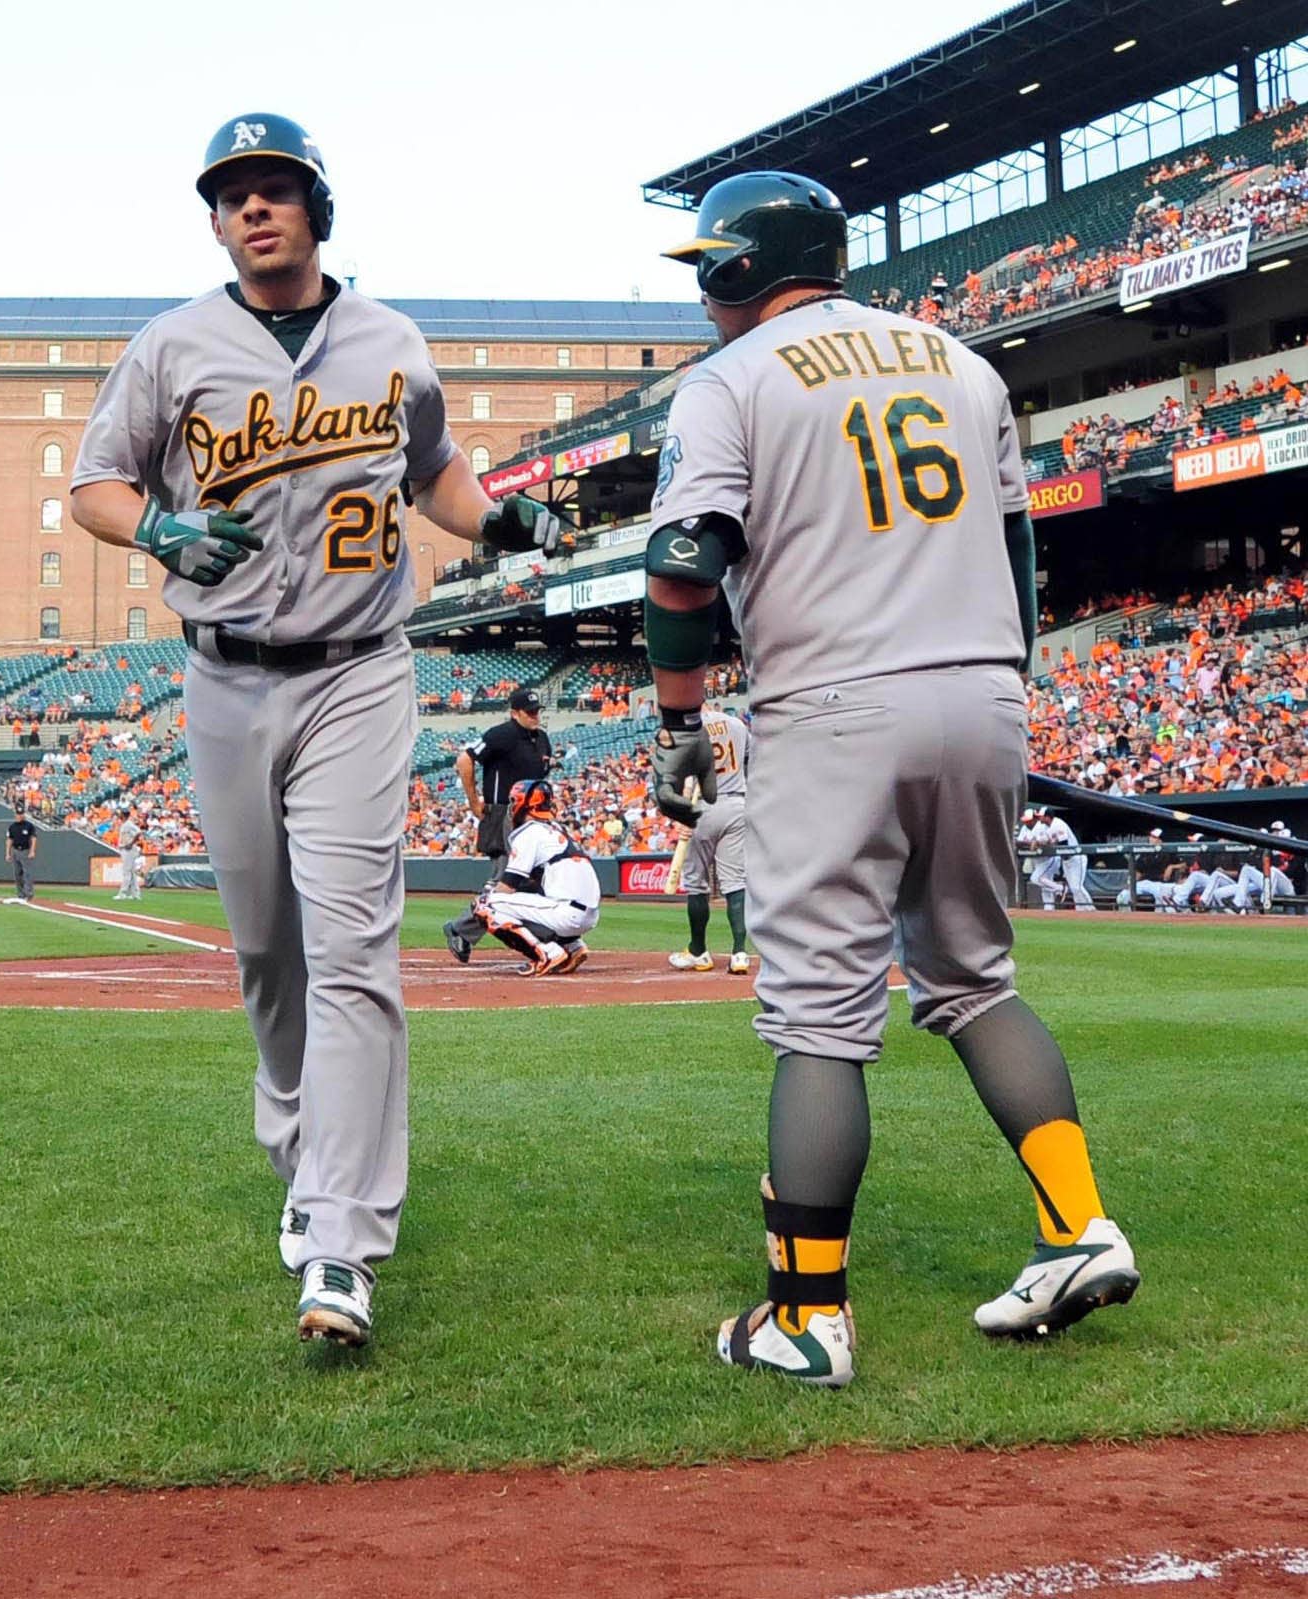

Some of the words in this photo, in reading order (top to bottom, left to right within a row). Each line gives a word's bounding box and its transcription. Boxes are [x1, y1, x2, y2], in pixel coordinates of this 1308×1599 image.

[1127, 255, 1195, 298] TILLMAN'S
[1200, 240, 1243, 275] TYKES
[775, 330, 955, 390] BUTLER
[184, 369, 406, 486] Oakland
[1286, 429, 1308, 446] ORIO
[841, 391, 968, 532] 16
[1176, 453, 1213, 482] NEED
[1216, 441, 1262, 471] HELP?
[1028, 481, 1083, 511] ARGO
[324, 486, 401, 574] 26
[707, 720, 729, 736] OGT
[711, 738, 738, 775] 21
